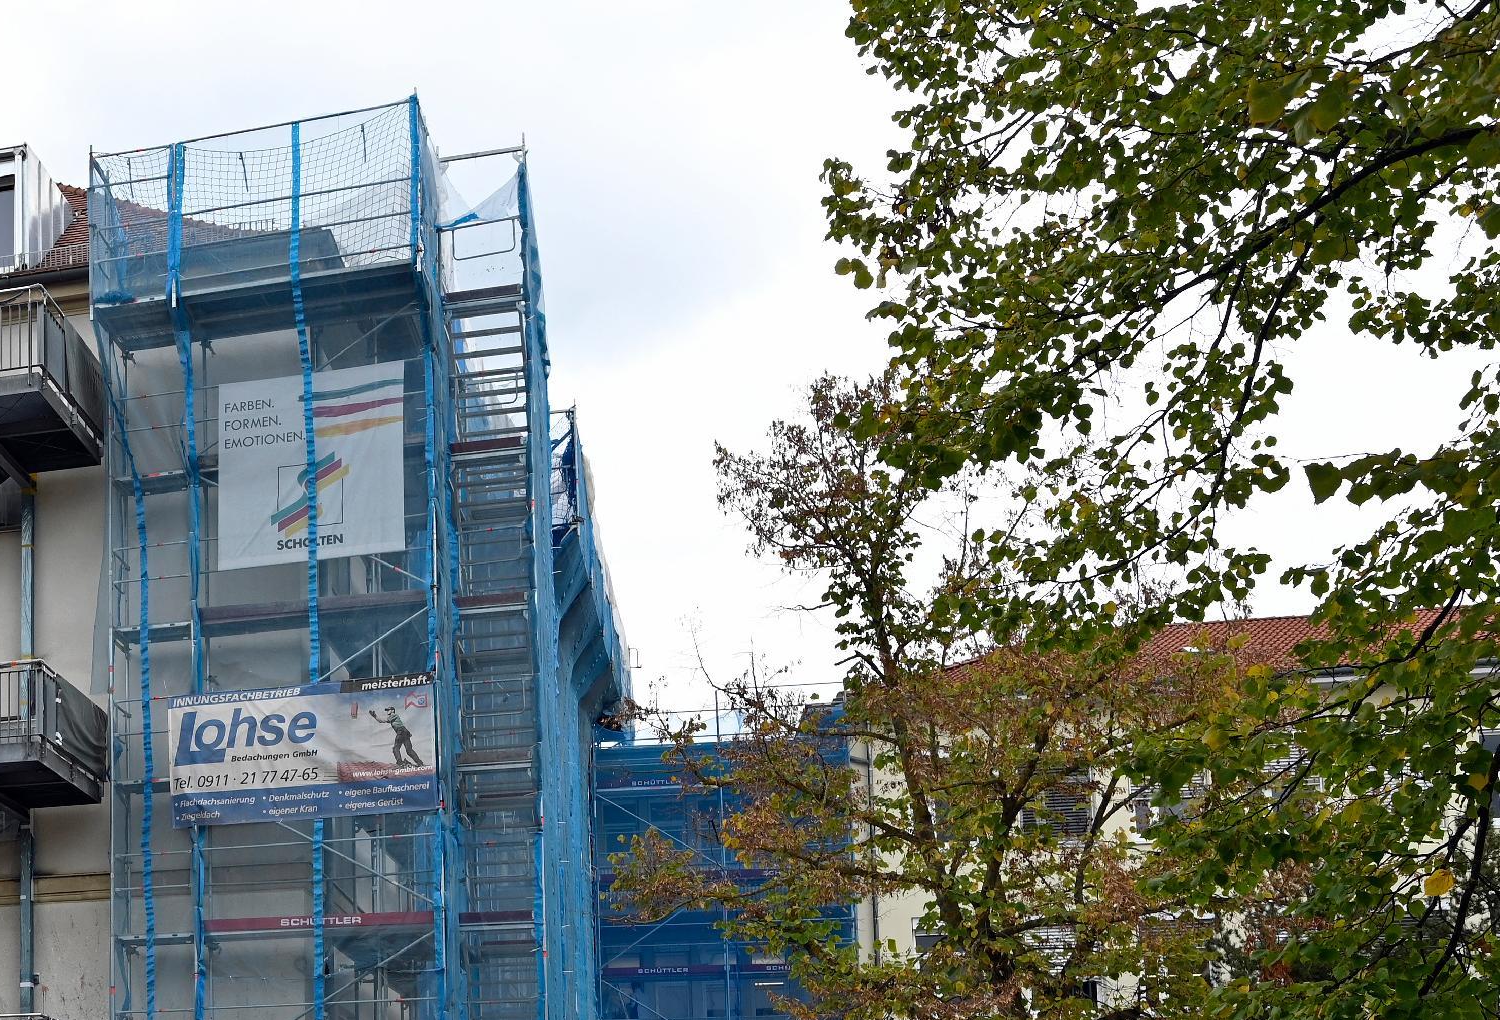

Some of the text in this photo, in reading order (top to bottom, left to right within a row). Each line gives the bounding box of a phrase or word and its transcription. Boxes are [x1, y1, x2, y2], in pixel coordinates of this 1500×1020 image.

[224, 398, 275, 414] FARBEN.
[224, 415, 282, 431] FORMEN.
[224, 431, 306, 450] EMOTIONEN.
[276, 533, 344, 550] SCHOTEN
[361, 674, 431, 691] meisterhaft.
[172, 687, 301, 708] INNUNGSFACHBETRIEB
[174, 708, 317, 767] Lohse
[231, 749, 318, 763] Bedachungen GmbH
[174, 776, 193, 790] Tel.
[197, 774, 229, 788] 0911
[240, 771, 256, 785] 21
[261, 770, 278, 784] 77
[280, 767, 319, 783] 47-65
[268, 791, 330, 802] Denkmalschutz
[344, 781, 430, 797] eigene Bauflaschnerei
[179, 796, 256, 808] Flachdachsanierung
[344, 798, 404, 811] eigenes Gerüst
[181, 810, 221, 821] Ziegeldach
[268, 805, 318, 816] eigener Kran
